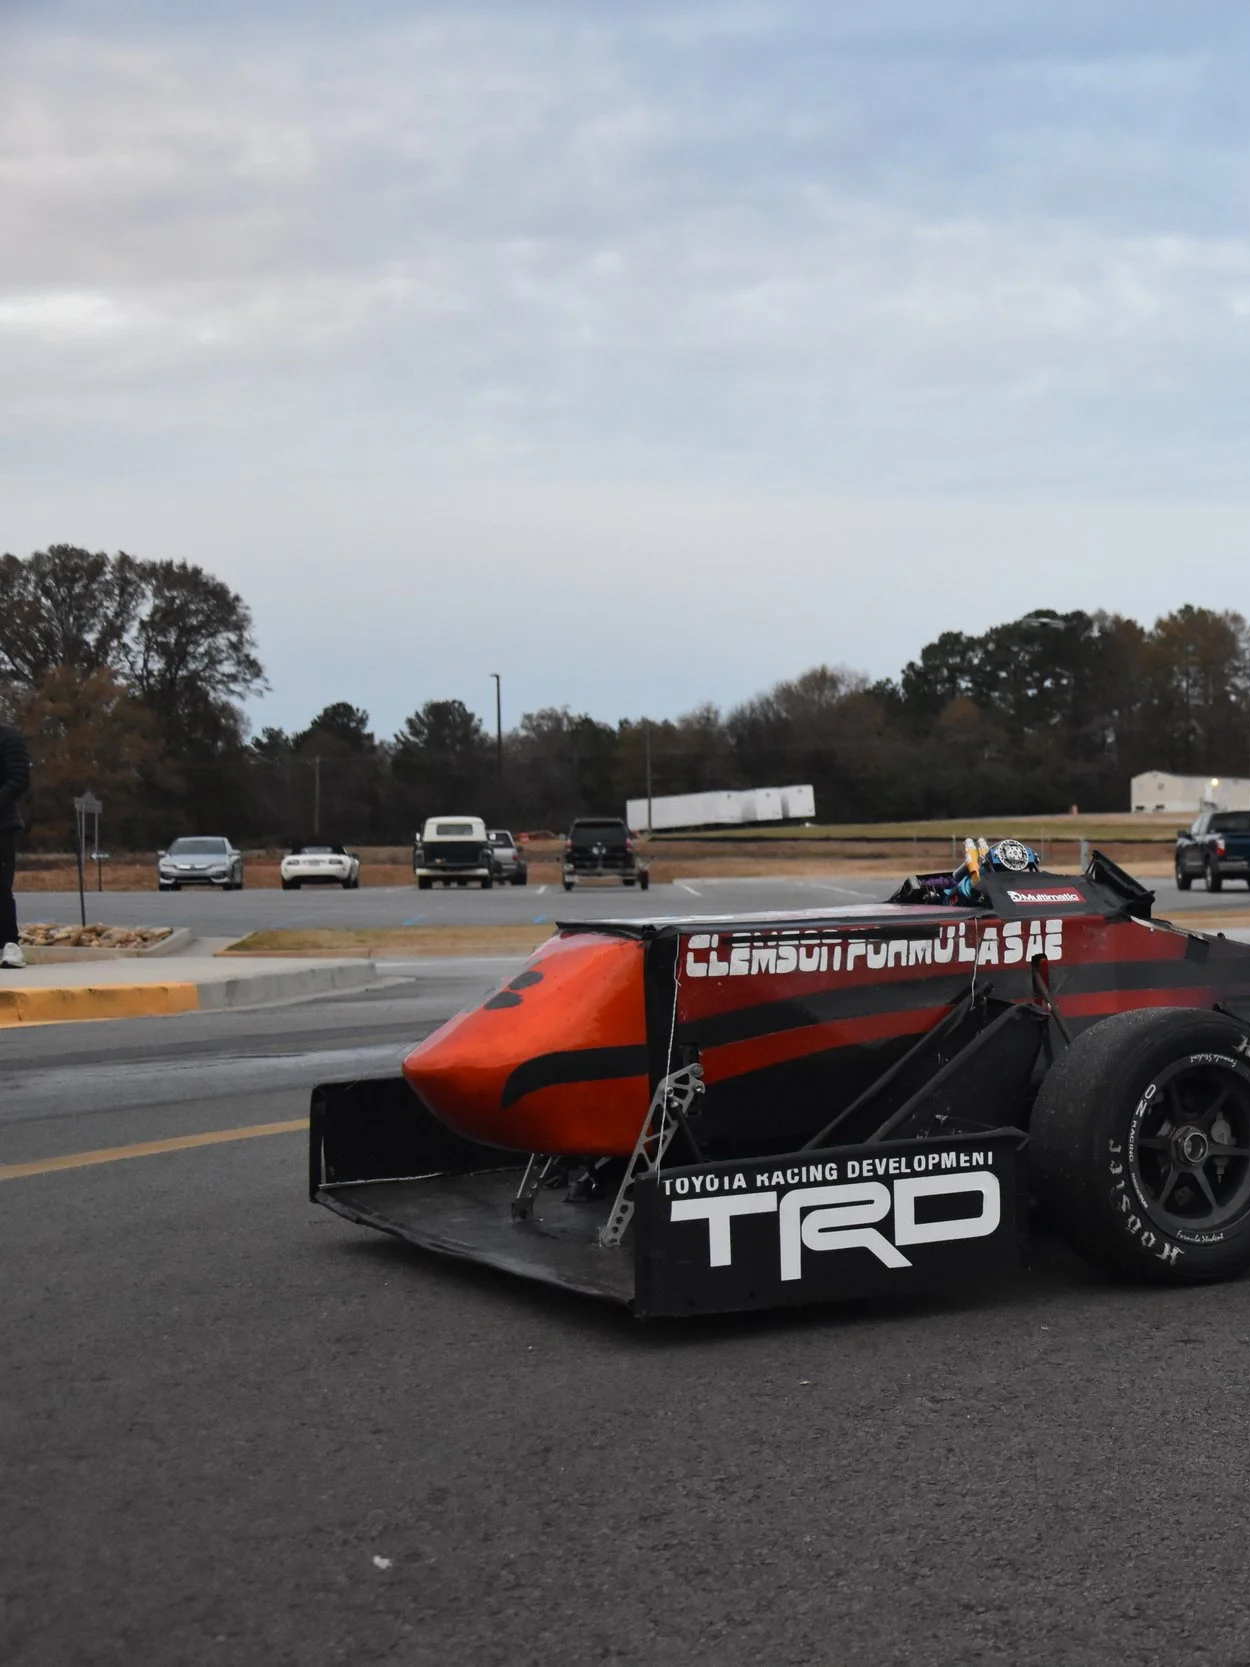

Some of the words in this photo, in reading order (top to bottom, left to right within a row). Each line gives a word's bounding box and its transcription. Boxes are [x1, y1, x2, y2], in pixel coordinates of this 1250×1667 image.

[1021, 892, 1080, 902] Multimatic
[663, 1172, 747, 1196] TOYOTA
[755, 1163, 838, 1187] RACING
[847, 1151, 995, 1179] DEVELOPMENT
[670, 1170, 1001, 1281] TRD
